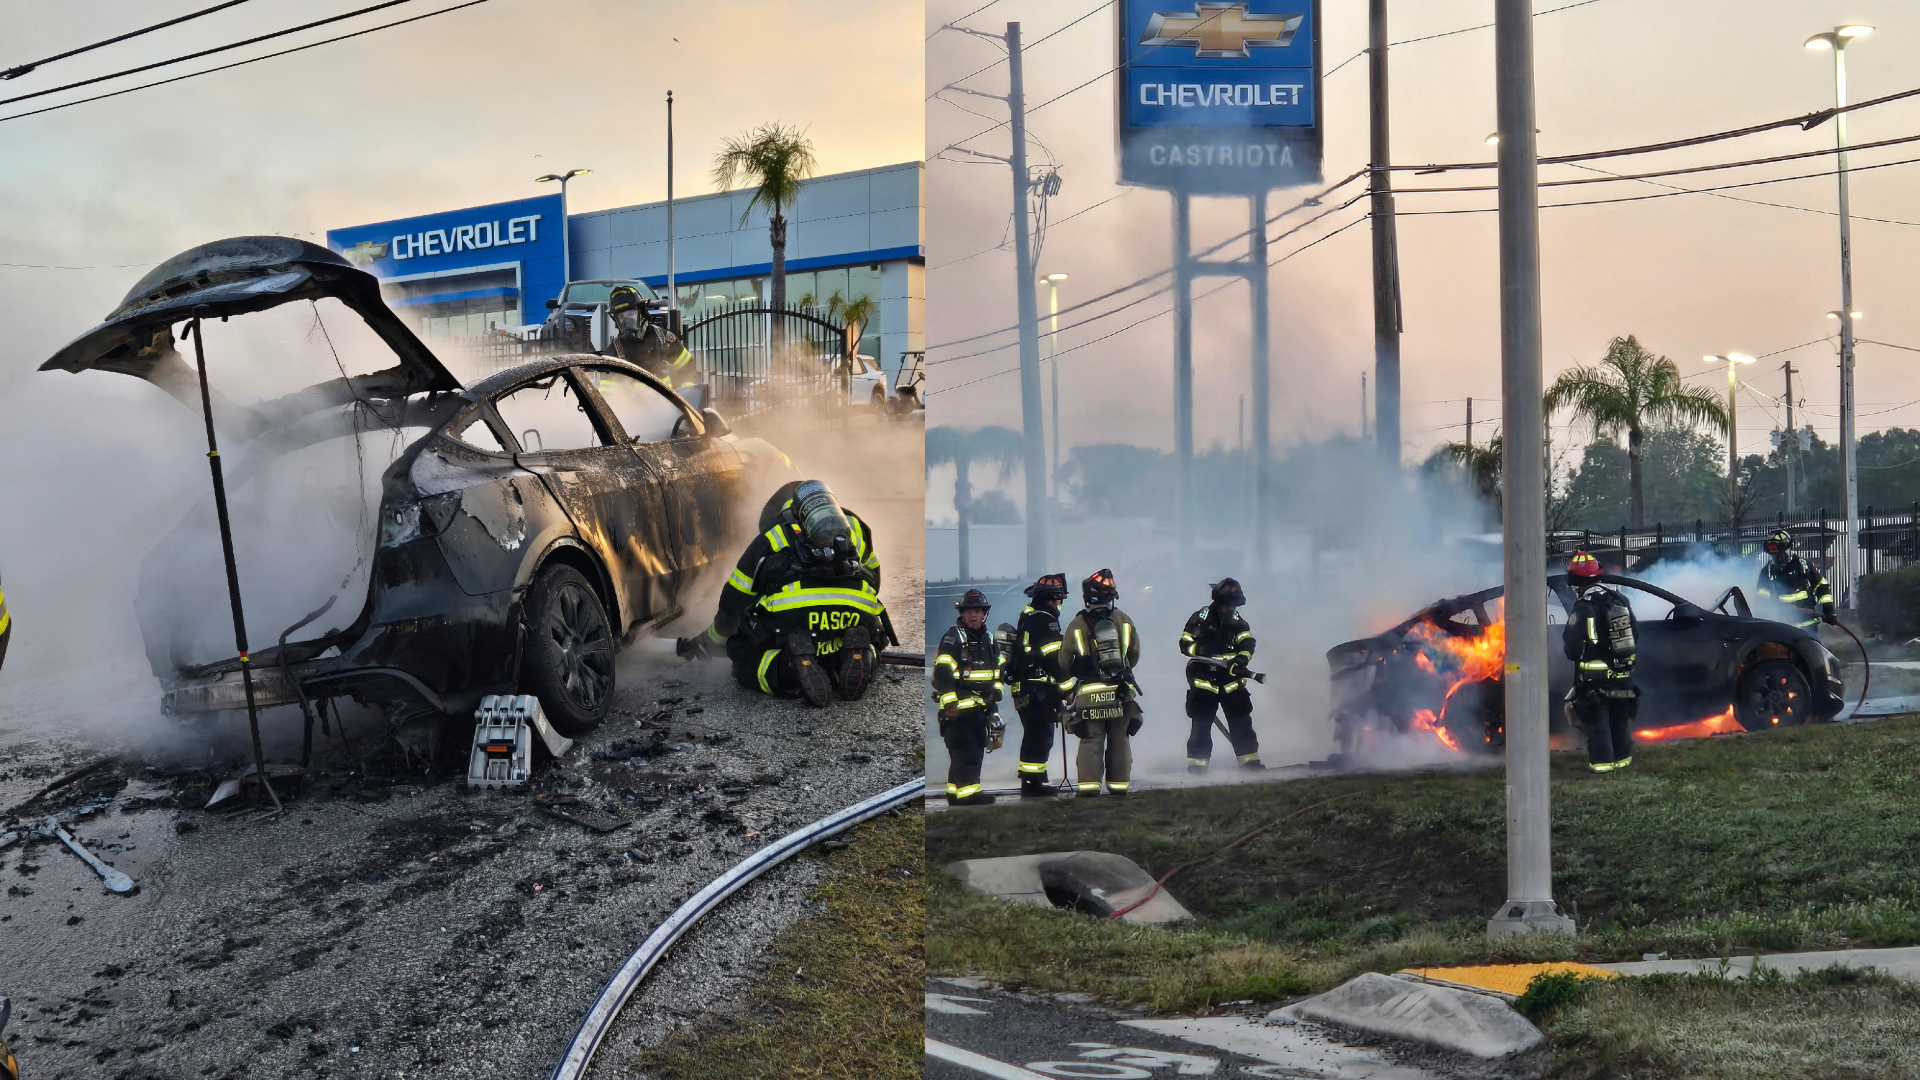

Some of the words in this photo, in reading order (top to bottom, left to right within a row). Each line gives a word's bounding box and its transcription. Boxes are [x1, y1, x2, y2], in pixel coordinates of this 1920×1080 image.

[1140, 83, 1304, 107] CHEVROLET
[1149, 144, 1295, 168] CASTRIOTA
[392, 214, 542, 260] CHEVROLET
[808, 611, 860, 631] PASCO
[816, 637, 844, 657] YOUN
[1090, 691, 1116, 703] PASCO
